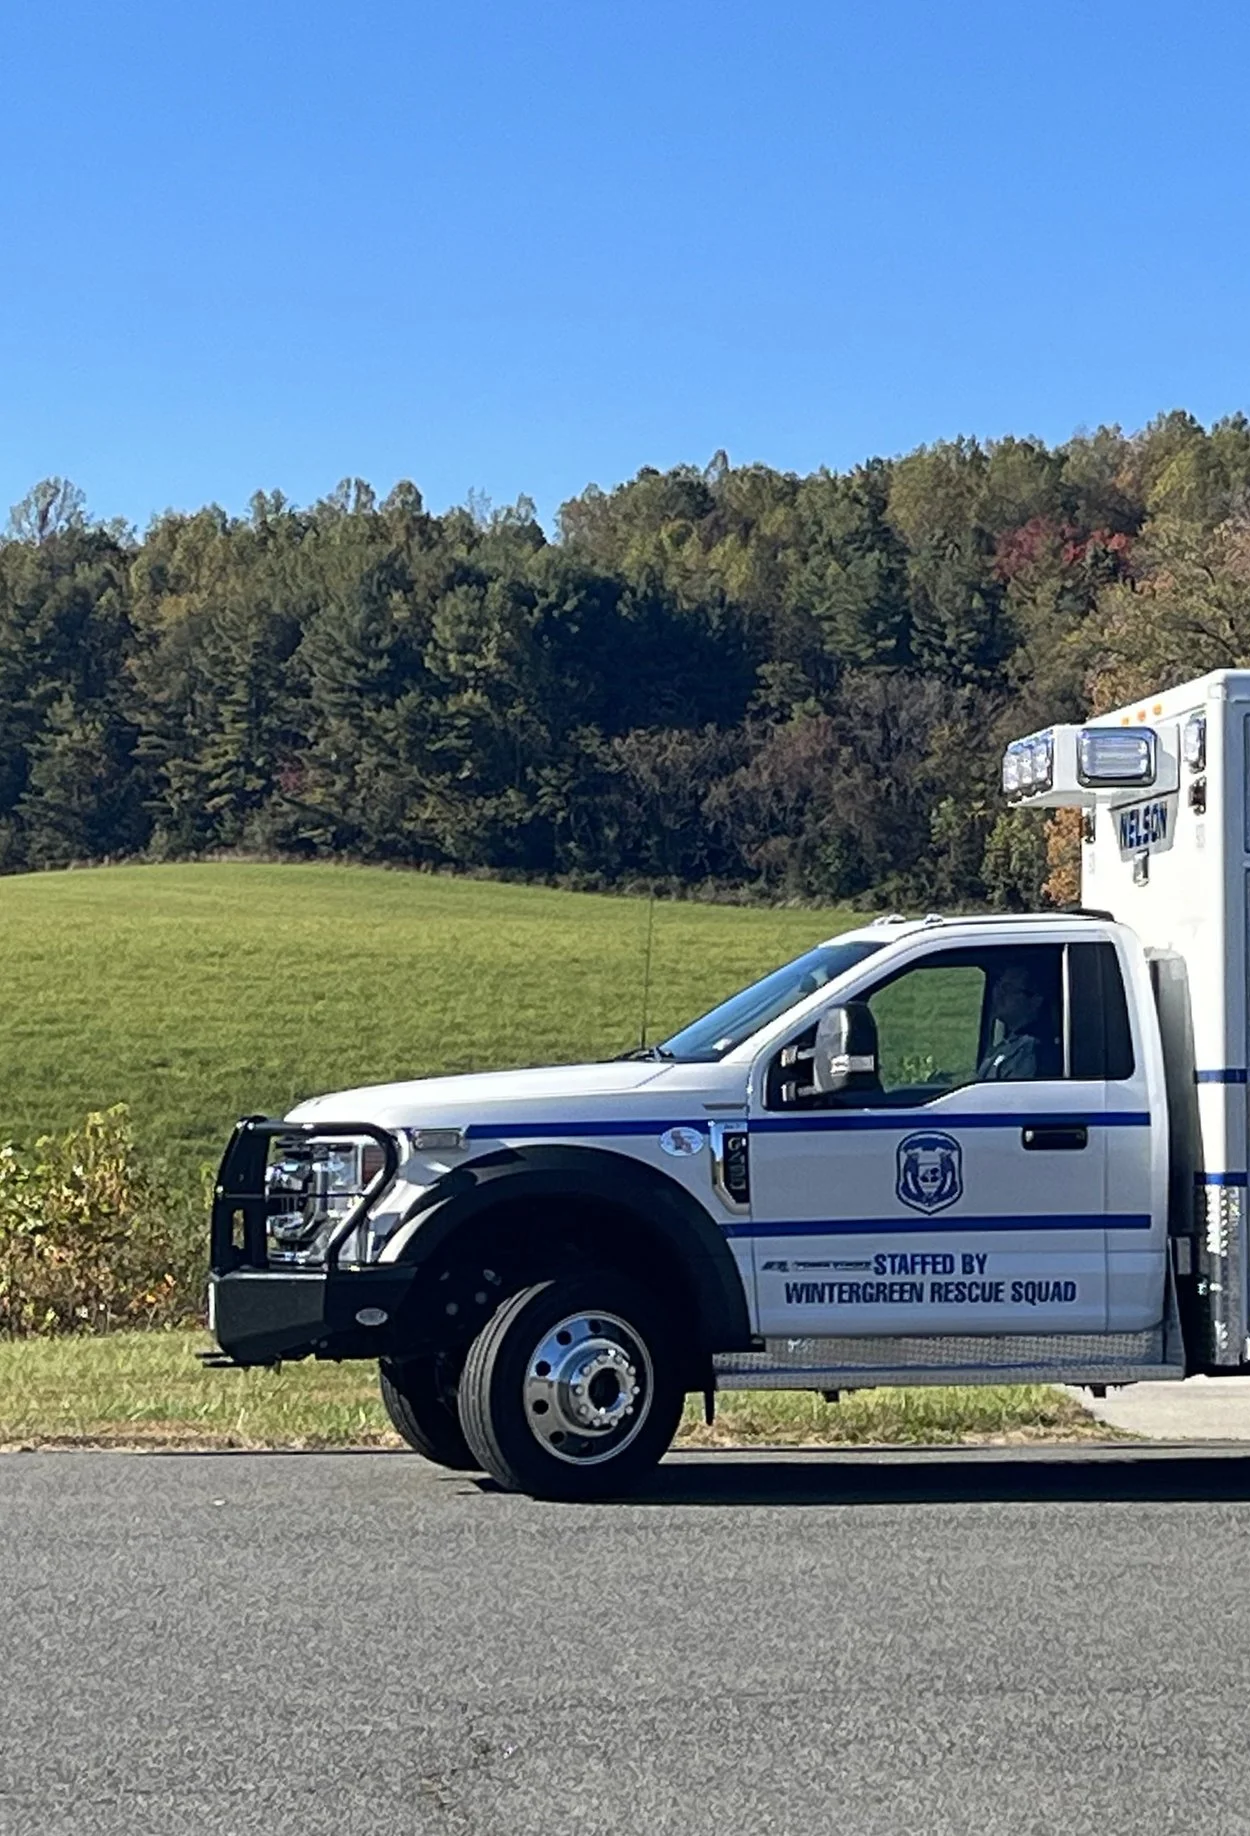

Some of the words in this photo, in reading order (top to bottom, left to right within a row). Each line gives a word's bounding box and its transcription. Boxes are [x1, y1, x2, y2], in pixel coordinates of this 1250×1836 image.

[1120, 801, 1167, 850] NELSON
[874, 1253, 955, 1276] STAFFED
[961, 1253, 988, 1276] BY
[785, 1281, 924, 1304] WINTERGREEN
[930, 1281, 1005, 1304] RESCUE
[1011, 1280, 1077, 1306] SQUAD
